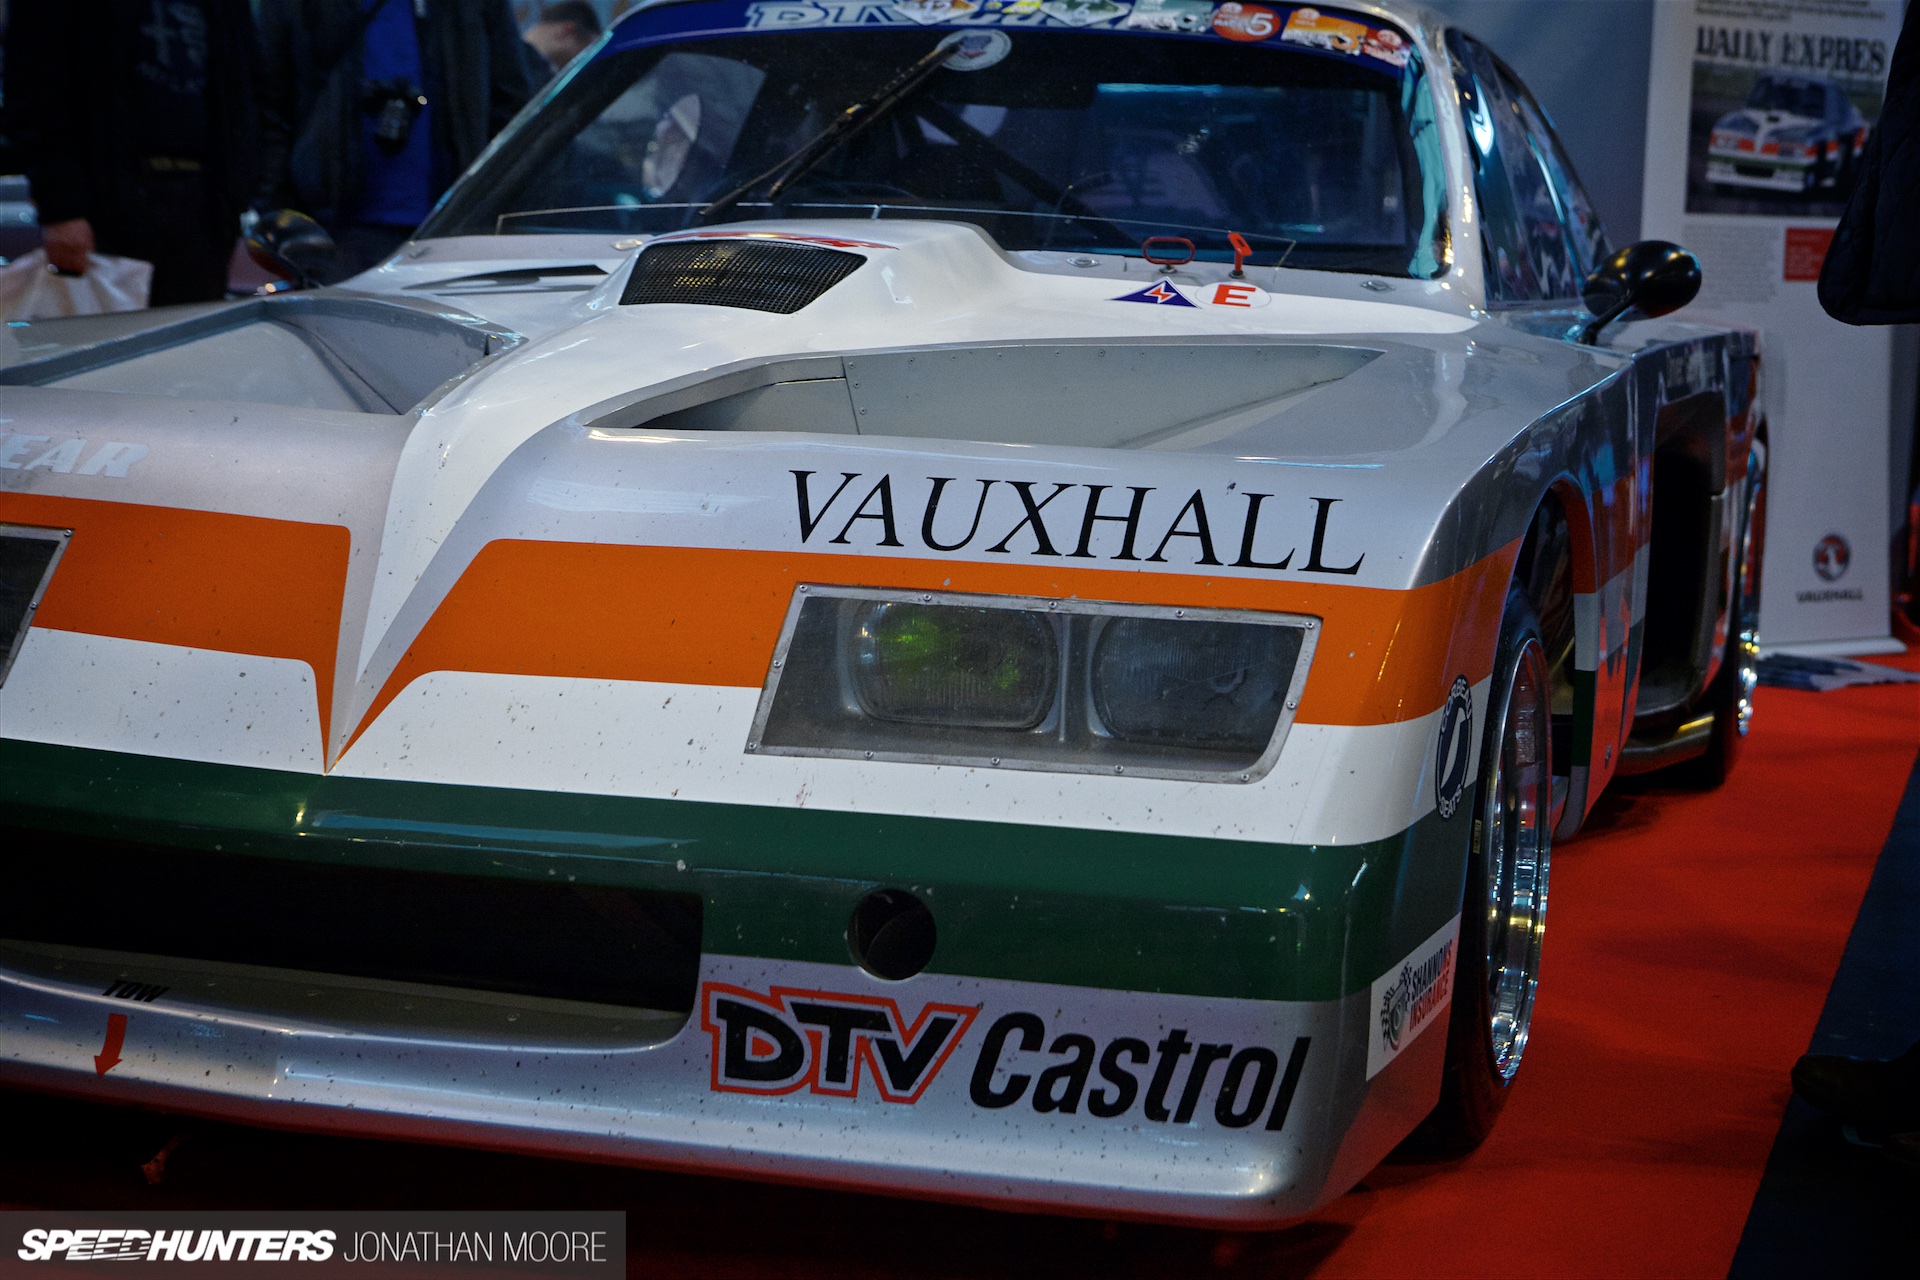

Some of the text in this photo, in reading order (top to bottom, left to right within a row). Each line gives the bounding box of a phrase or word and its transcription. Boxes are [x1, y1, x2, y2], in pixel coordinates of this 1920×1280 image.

[1244, 12, 1274, 36] 5
[1696, 25, 1773, 63] DAILY
[1212, 284, 1256, 308] E
[0, 432, 149, 478] EAR
[788, 469, 1366, 576] VAUXHALL
[103, 980, 169, 1002] TOW
[1409, 969, 1450, 1032] INSURANCE
[706, 986, 1311, 1131] DTV Castrol
